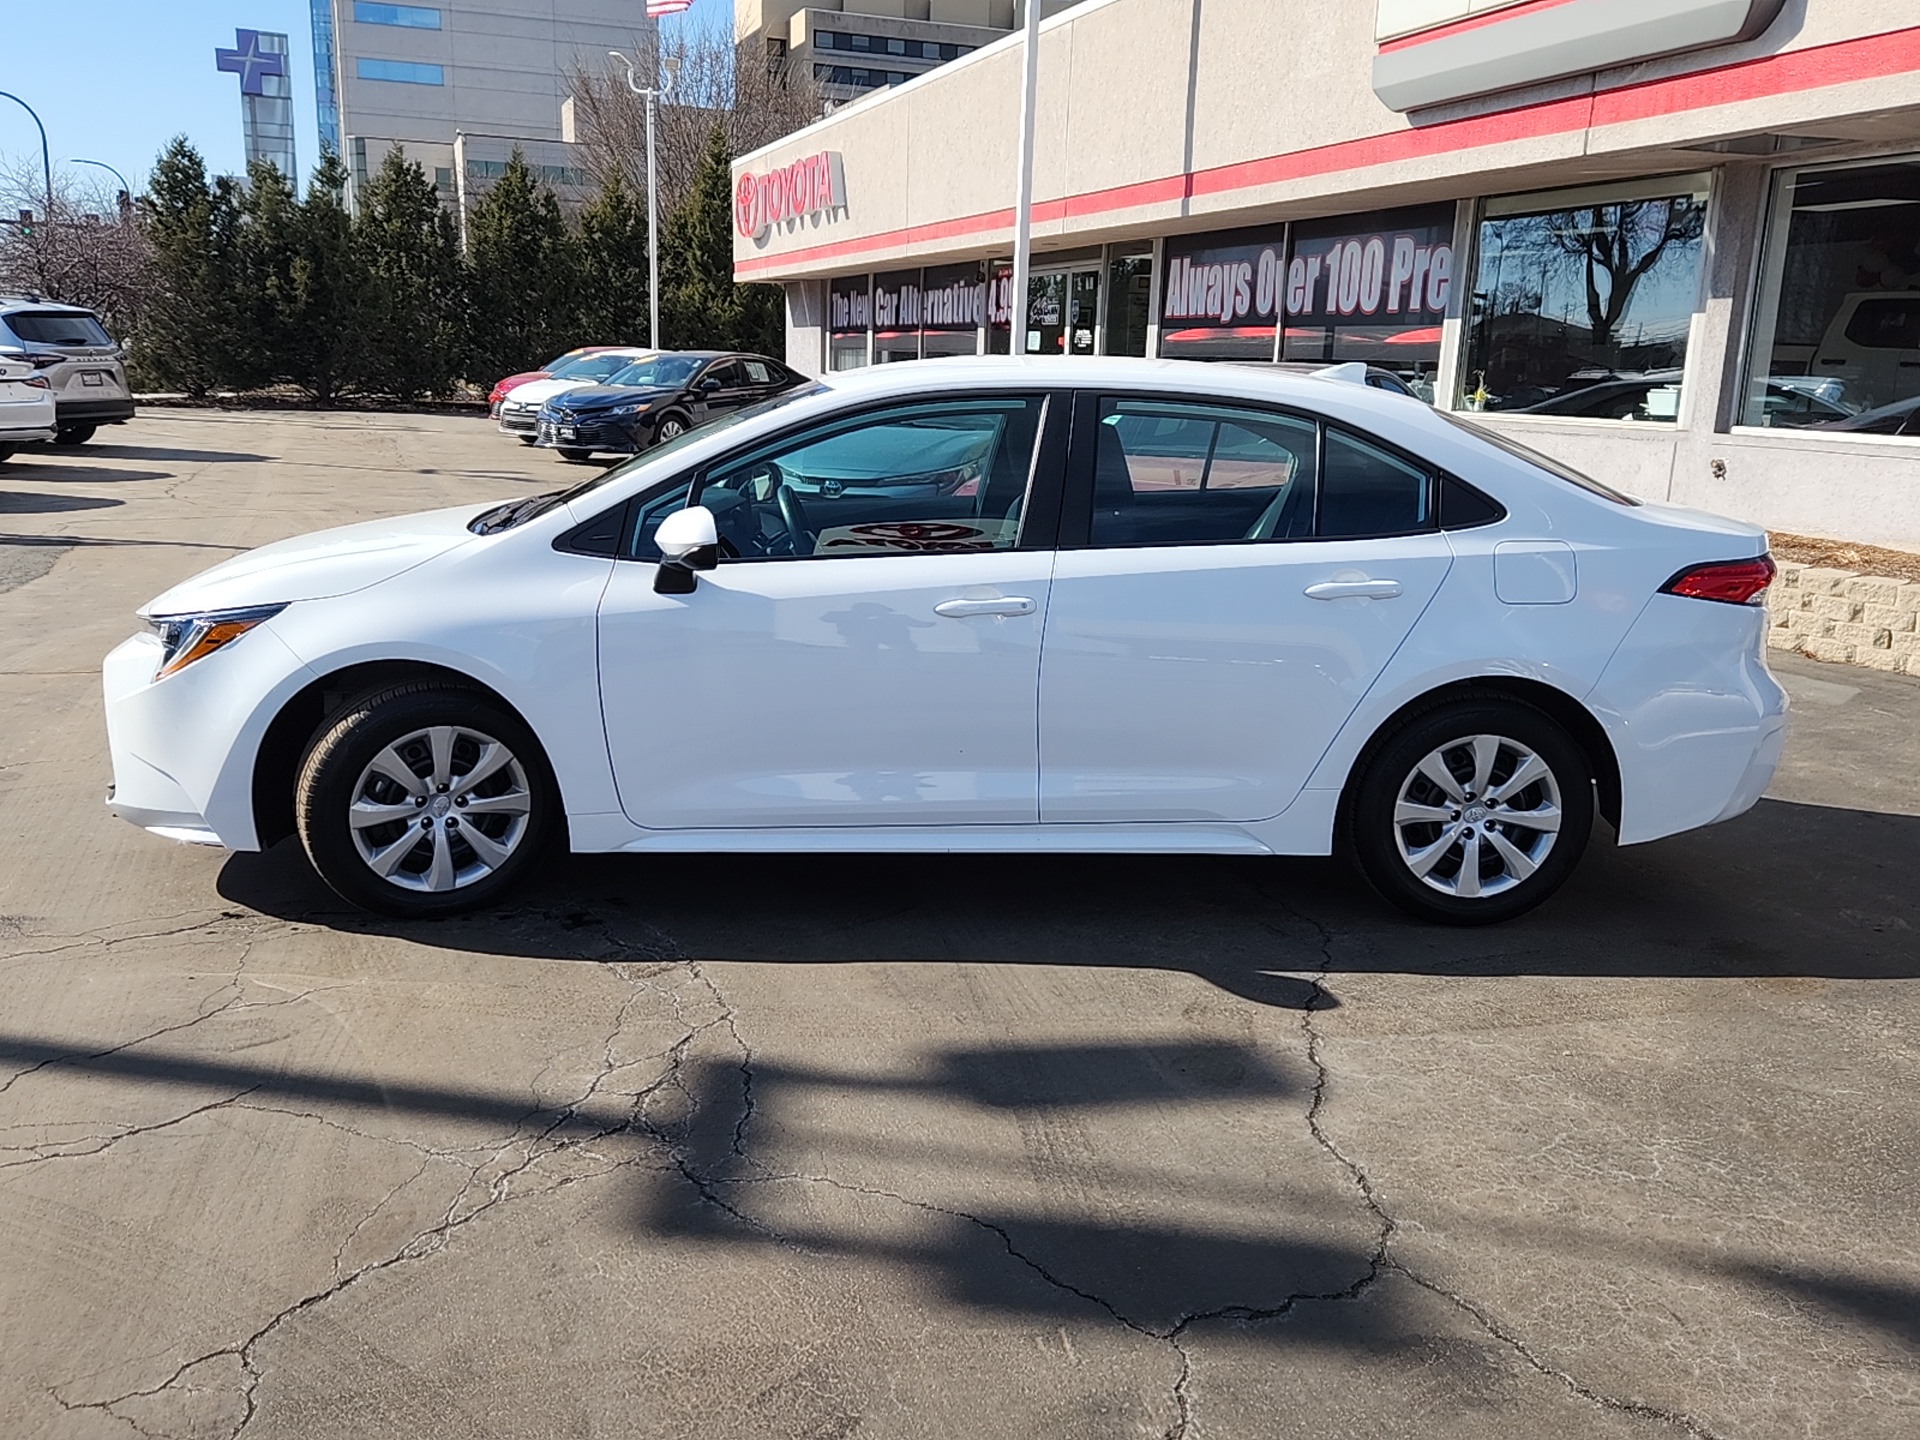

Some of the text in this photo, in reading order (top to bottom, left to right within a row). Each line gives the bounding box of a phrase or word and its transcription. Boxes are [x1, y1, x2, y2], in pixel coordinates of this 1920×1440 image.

[758, 151, 832, 225] TOYOTA
[832, 292, 849, 328] The
[850, 290, 869, 327] New
[875, 287, 899, 327] Car
[899, 280, 984, 326] Alternative
[1165, 254, 1252, 324] Always
[1325, 235, 1385, 316] 100
[1386, 234, 1453, 314] Pre
